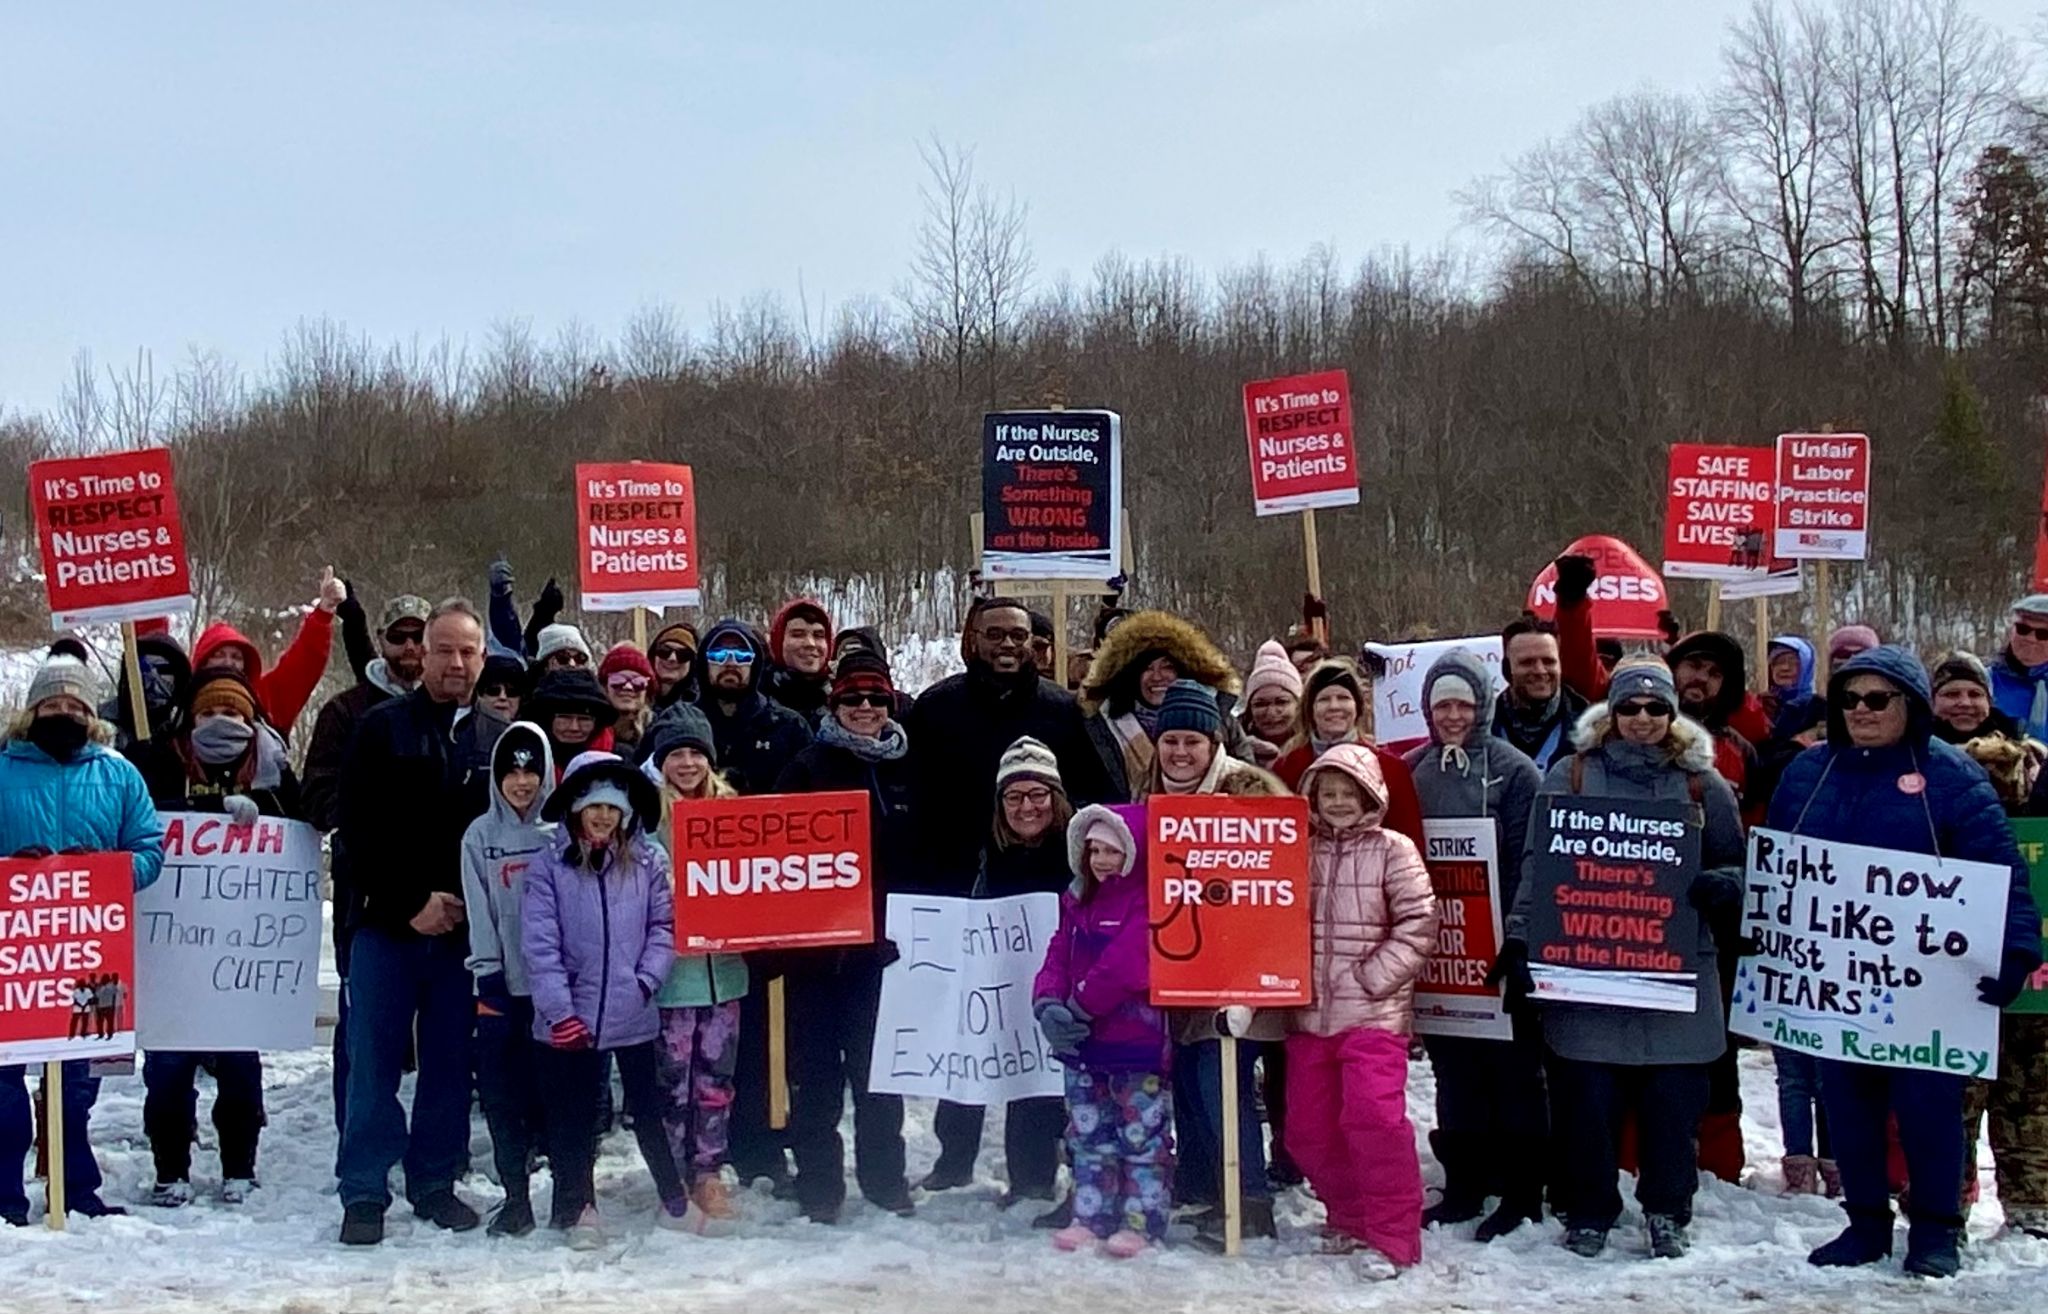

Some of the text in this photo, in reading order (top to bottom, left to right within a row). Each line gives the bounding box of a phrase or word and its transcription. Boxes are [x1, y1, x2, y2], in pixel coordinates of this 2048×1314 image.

[1255, 388, 1339, 413] It's Time to
[996, 424, 1100, 442] If the Nurses
[1258, 407, 1341, 434] RESPECT
[996, 444, 1098, 464] Are Outside,
[1259, 432, 1345, 458] Nurses &
[1792, 441, 1858, 459] Unfair
[1016, 464, 1078, 481] There's
[1261, 453, 1347, 482] Patients
[1697, 456, 1749, 477] SAFE
[1793, 464, 1854, 481] Labor
[44, 471, 161, 500] It's Time to
[588, 479, 683, 498] It's Time to
[1002, 486, 1092, 505] Something
[1673, 477, 1770, 501] STAFFING
[1781, 485, 1865, 504] Practice
[48, 494, 164, 527] RESPECT
[589, 501, 684, 521] RESPECT
[1007, 507, 1087, 527] WRONG
[1687, 502, 1754, 523] SAVES
[1790, 508, 1853, 525] Strike
[52, 526, 171, 557] Nurses &
[589, 525, 686, 547] Nurses &
[994, 534, 1014, 547] on
[1019, 531, 1046, 547] the
[1678, 524, 1736, 546] LIVES
[57, 553, 176, 587] Patients
[591, 549, 688, 574] Patients
[686, 808, 858, 849] RESPECT
[1159, 816, 1298, 844] PATIENTS
[1550, 809, 1684, 838] If the Nurses
[163, 818, 284, 856] ACMH
[1429, 837, 1477, 857] STRIKE
[1549, 834, 1682, 866] Are Outside,
[1186, 849, 1272, 869] BEFORE
[163, 864, 321, 901] TIGHTER
[687, 852, 862, 897] NURSES
[1436, 866, 1486, 891] STING
[1576, 860, 1655, 886] There's
[9, 870, 90, 903] SAFE
[1437, 898, 1466, 926] AIR
[1555, 884, 1673, 917] Something
[0, 903, 126, 939] TAFFING
[141, 911, 307, 948] Than a BP
[1562, 912, 1664, 944] WRONG
[1915, 913, 1969, 957] to
[0, 940, 102, 975] SAVES
[1542, 943, 1682, 971] on the Inside
[1848, 951, 1922, 988] into
[212, 955, 303, 995] CUFF!
